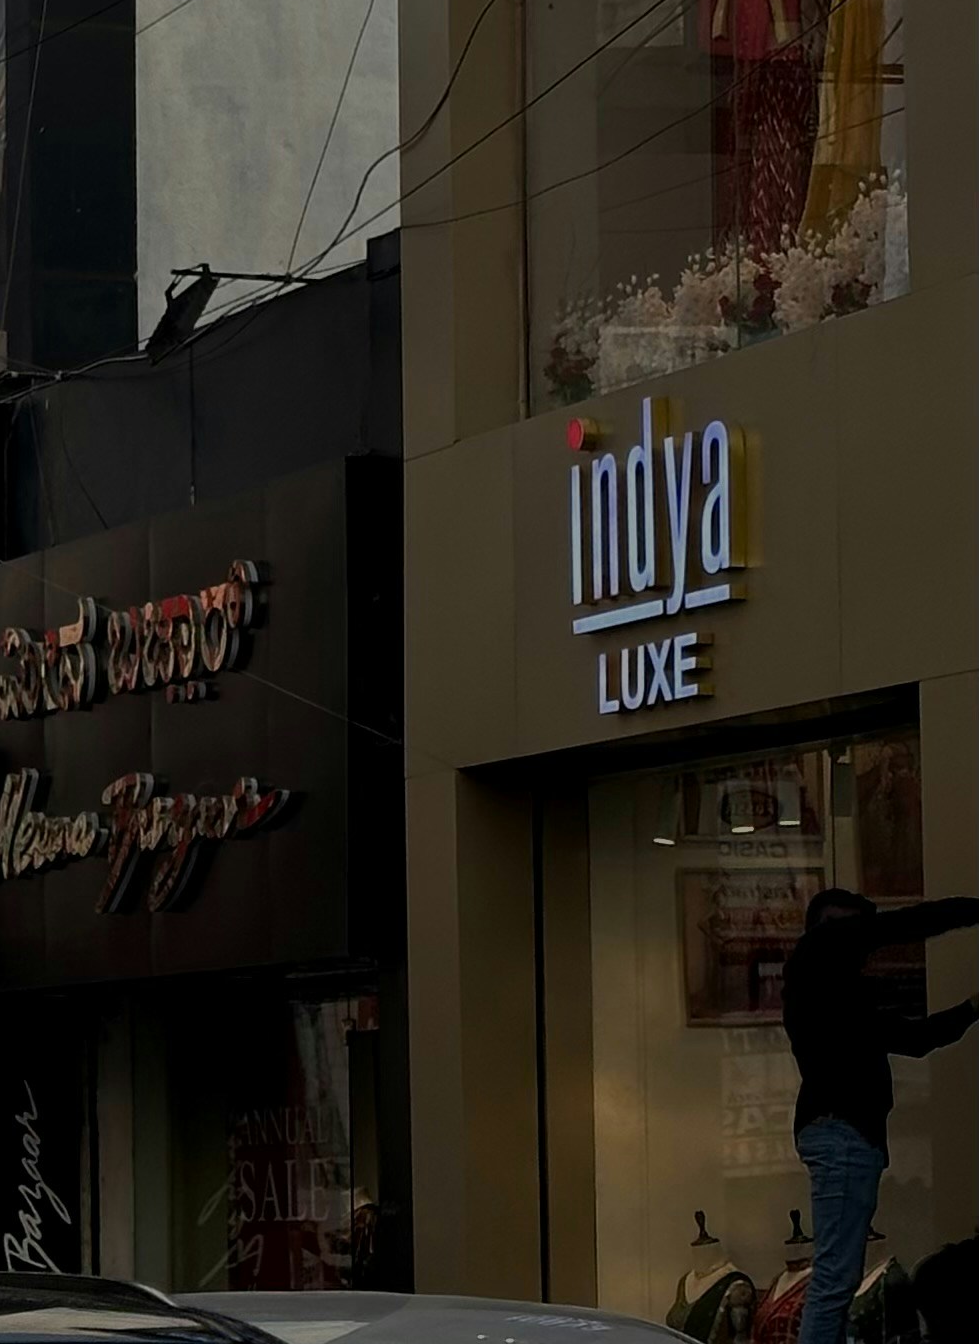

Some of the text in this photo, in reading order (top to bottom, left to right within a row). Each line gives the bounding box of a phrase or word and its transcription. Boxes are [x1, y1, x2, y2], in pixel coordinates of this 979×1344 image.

[566, 396, 732, 618] indya
[597, 631, 699, 715] LUXE
[236, 1104, 329, 1146] ANNUAL
[2, 1079, 73, 1274] Bazaar
[238, 1158, 332, 1223] SALE
